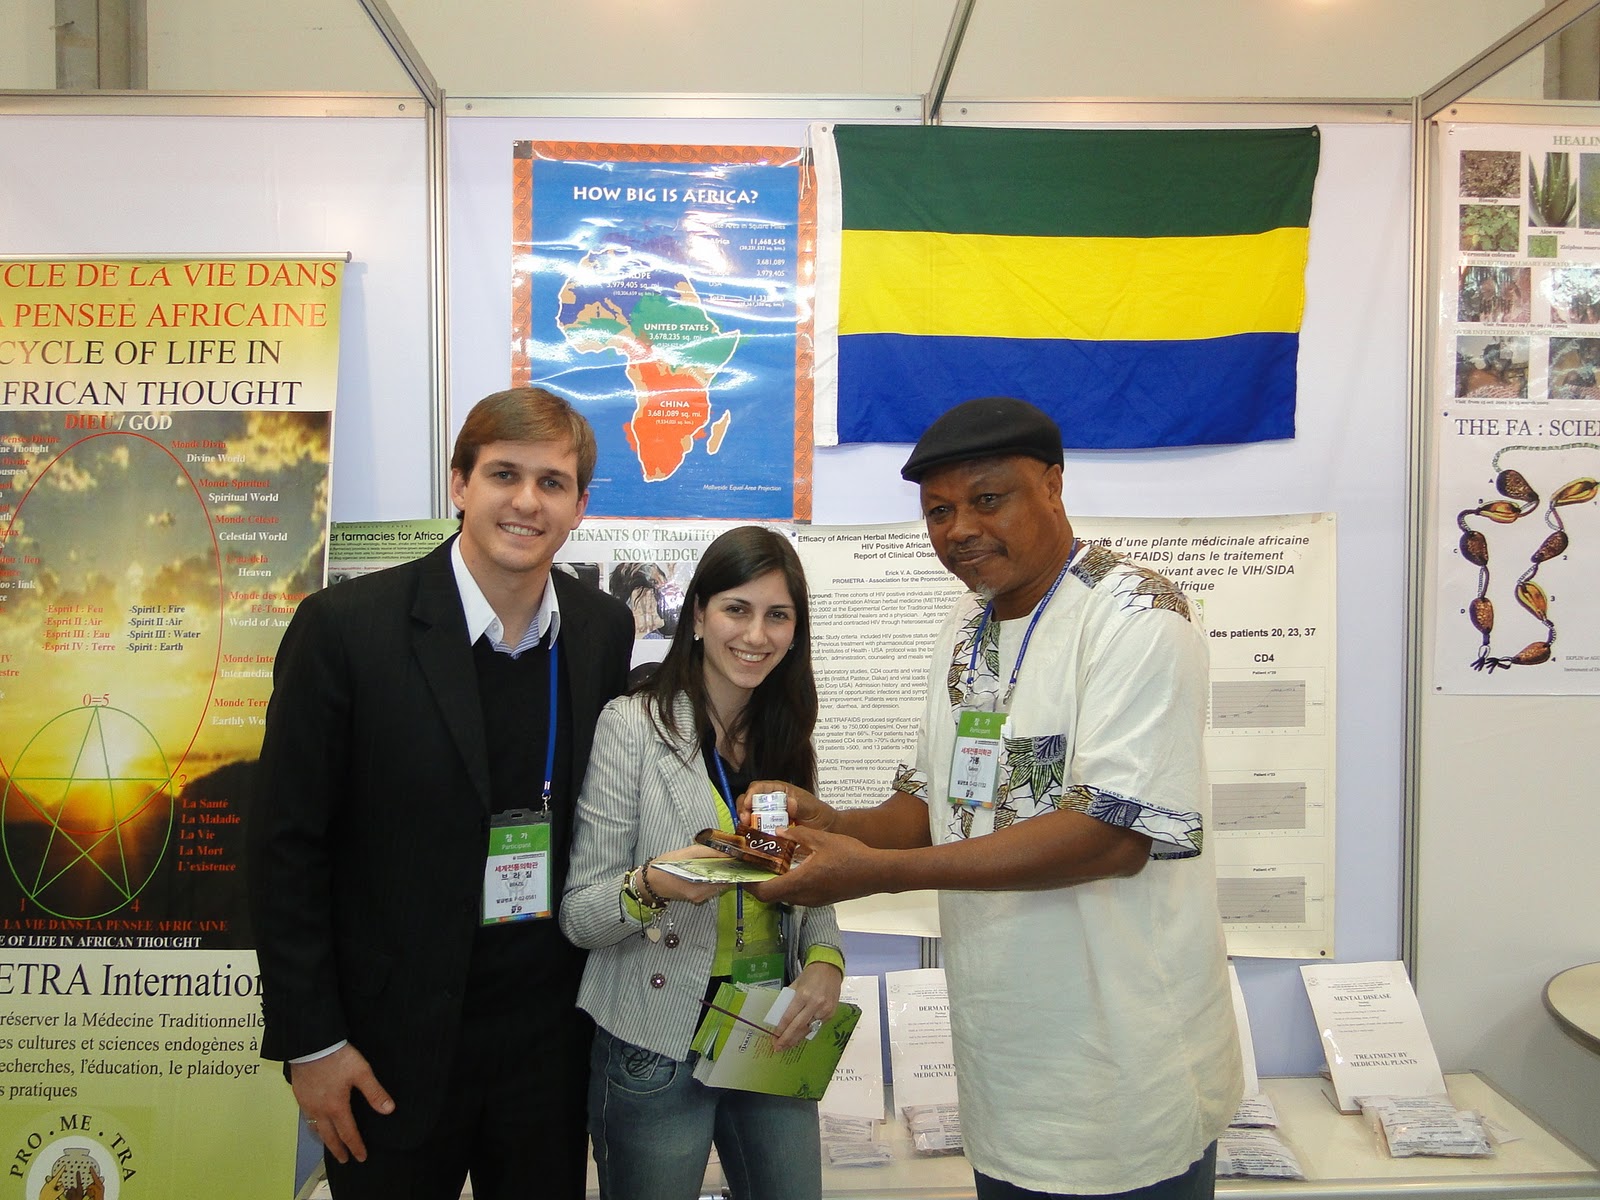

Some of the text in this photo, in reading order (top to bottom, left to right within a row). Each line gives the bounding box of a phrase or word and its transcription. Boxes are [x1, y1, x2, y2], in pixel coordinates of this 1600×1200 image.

[573, 186, 759, 204] HOW BIG IS AFRICA?
[75, 263, 120, 287] DE
[128, 266, 172, 287] LA
[182, 263, 237, 287] VIE
[245, 262, 338, 288] DANS
[13, 303, 328, 329] PENSEE AFRICAINE
[643, 323, 709, 332] UNITED STATES
[0, 340, 283, 365] CYCLE OF LIFE IN
[0, 380, 303, 406] FRICAN THOUGHT
[659, 400, 690, 408] CHINA
[65, 414, 114, 430] DIEU
[128, 414, 173, 431] GOD
[1455, 419, 1600, 436] THE FA SCIE
[12, 444, 49, 455] Thought
[186, 453, 246, 463] Divine World
[199, 479, 229, 488] Monde
[208, 493, 279, 504] Spiritual World
[215, 515, 245, 524] Monde
[219, 531, 288, 541] Celestial World
[342, 531, 444, 541] farmacies for Africa
[570, 529, 650, 542] TENANTS OF
[798, 535, 826, 545] Efficacy
[827, 535, 836, 543] of
[836, 534, 862, 543] African
[888, 533, 920, 541] Medicine
[875, 542, 904, 550] Positive
[1115, 536, 1310, 550] d'une plante médicinale africaine
[613, 548, 699, 562] KNOWLEDGE
[853, 552, 878, 561] Report
[888, 551, 915, 559] Clinical
[1177, 550, 1284, 561] dans le traitement
[238, 567, 272, 577] Heaven
[1158, 564, 1295, 576] vivant avec le VIH/SIDA
[229, 591, 277, 600] Monde des
[129, 605, 186, 616] -Spirit Fire
[128, 618, 154, 628] -Spirit
[229, 617, 270, 627] World of
[93, 630, 111, 639] Eau
[127, 630, 201, 641] -Spirit Water
[1209, 628, 1316, 640] des patients 20, 23, 37
[92, 643, 116, 652] Terre
[126, 642, 184, 653] -Spirit Earth
[223, 655, 254, 663] Monde
[1254, 654, 1275, 662] CD4
[83, 693, 110, 708] 0=5
[214, 698, 245, 707] Monde
[212, 716, 245, 728] Earthly
[178, 774, 188, 788] 2
[182, 798, 229, 809] La Santé
[181, 814, 241, 824] La Maladie
[180, 829, 216, 840] La Vie
[178, 845, 224, 856] La Mort
[177, 860, 236, 872] L'existence
[131, 898, 141, 912] 4
[158, 920, 228, 932] AFRICAINE
[8, 935, 202, 948] OF LIFE IN AFRICAN THOUGHT
[64, 1012, 77, 1027] la
[82, 1012, 154, 1028] Médecine
[159, 1012, 265, 1028] Traditionnelle
[18, 1035, 259, 1055] cultures et sciences endogènes à
[1355, 1052, 1397, 1060] TREATMENT
[1350, 1058, 1418, 1067] MEDICINAL PLANTS
[80, 1058, 260, 1079] l'éducation, le plaidoyer
[913, 1071, 953, 1079] MEDICINAL
[9, 1082, 78, 1101] pratiques
